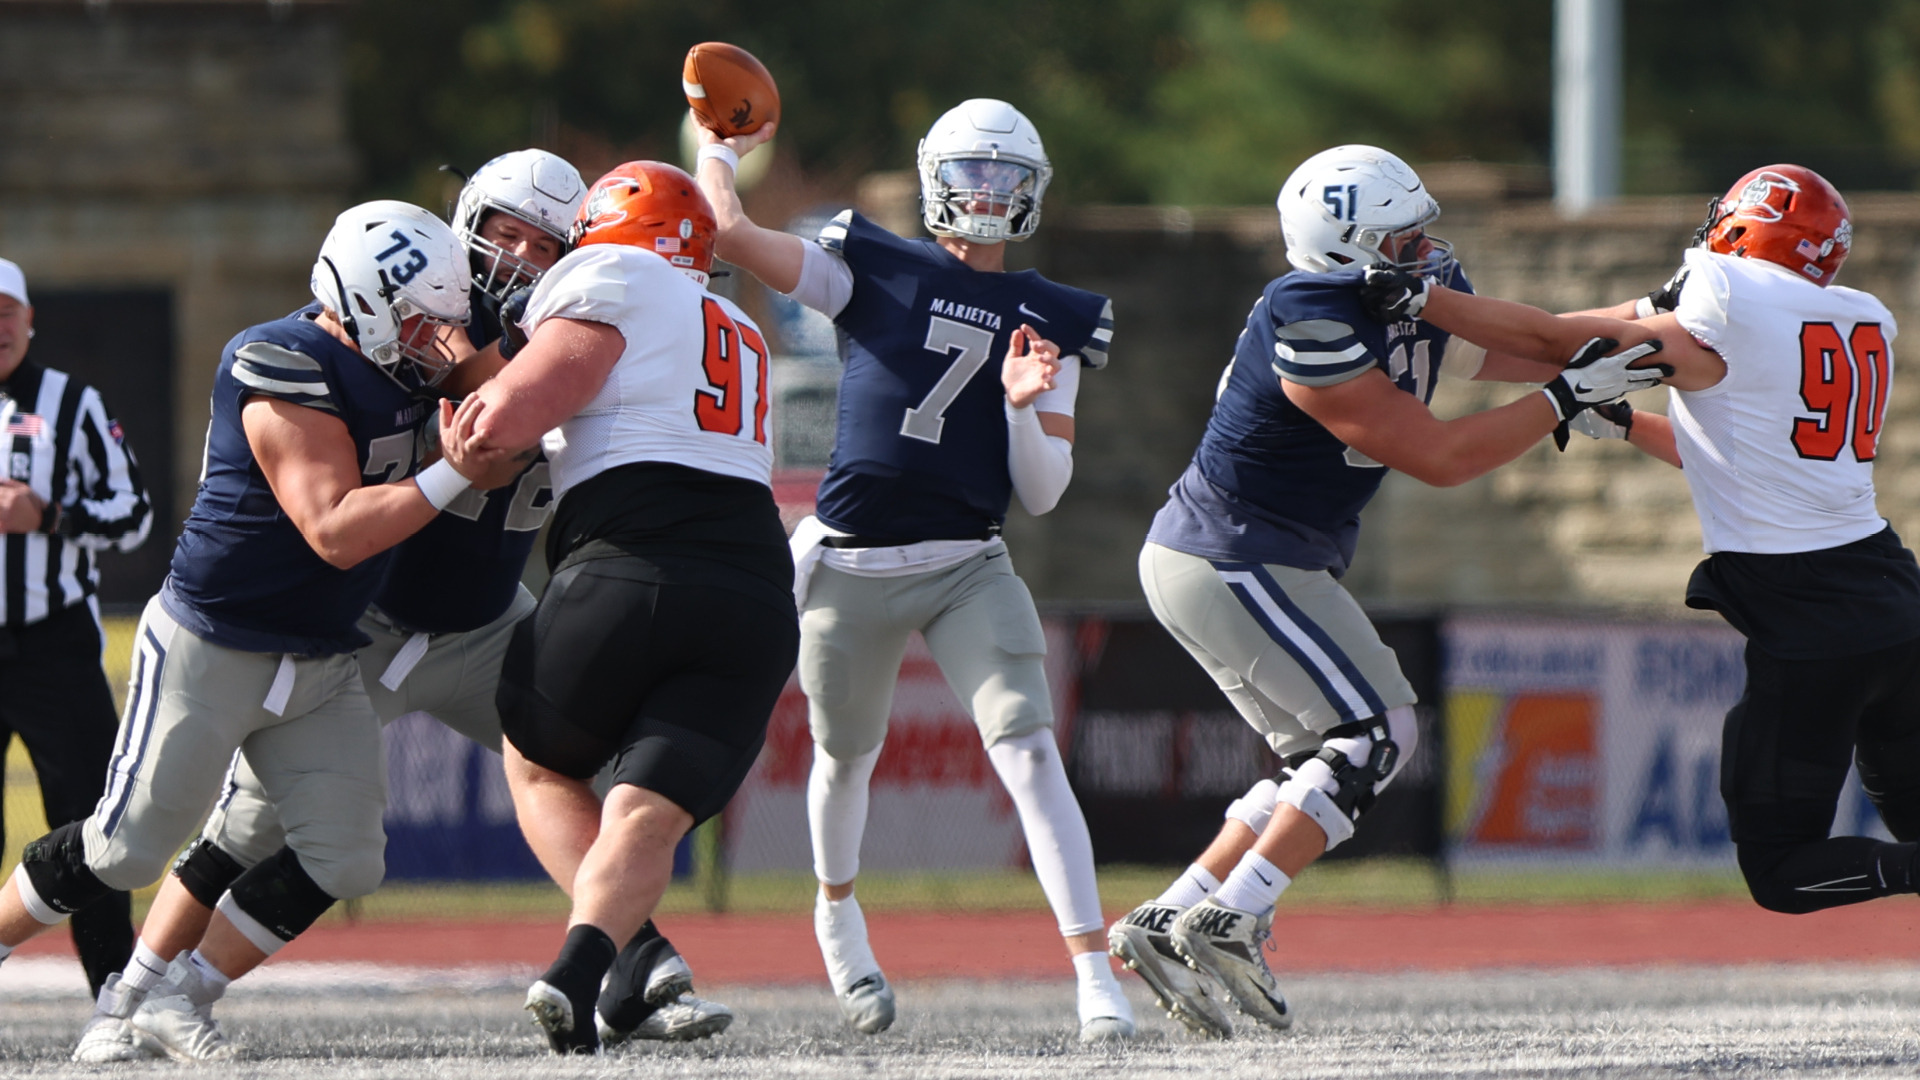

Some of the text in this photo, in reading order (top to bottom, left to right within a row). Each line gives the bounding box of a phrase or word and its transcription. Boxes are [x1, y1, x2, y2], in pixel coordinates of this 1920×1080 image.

[1323, 184, 1358, 222] 51
[375, 230, 429, 286] 73
[929, 297, 1002, 329] MARIETTA
[693, 296, 769, 447] 97
[899, 315, 996, 445] 7
[1790, 320, 1890, 463] 90
